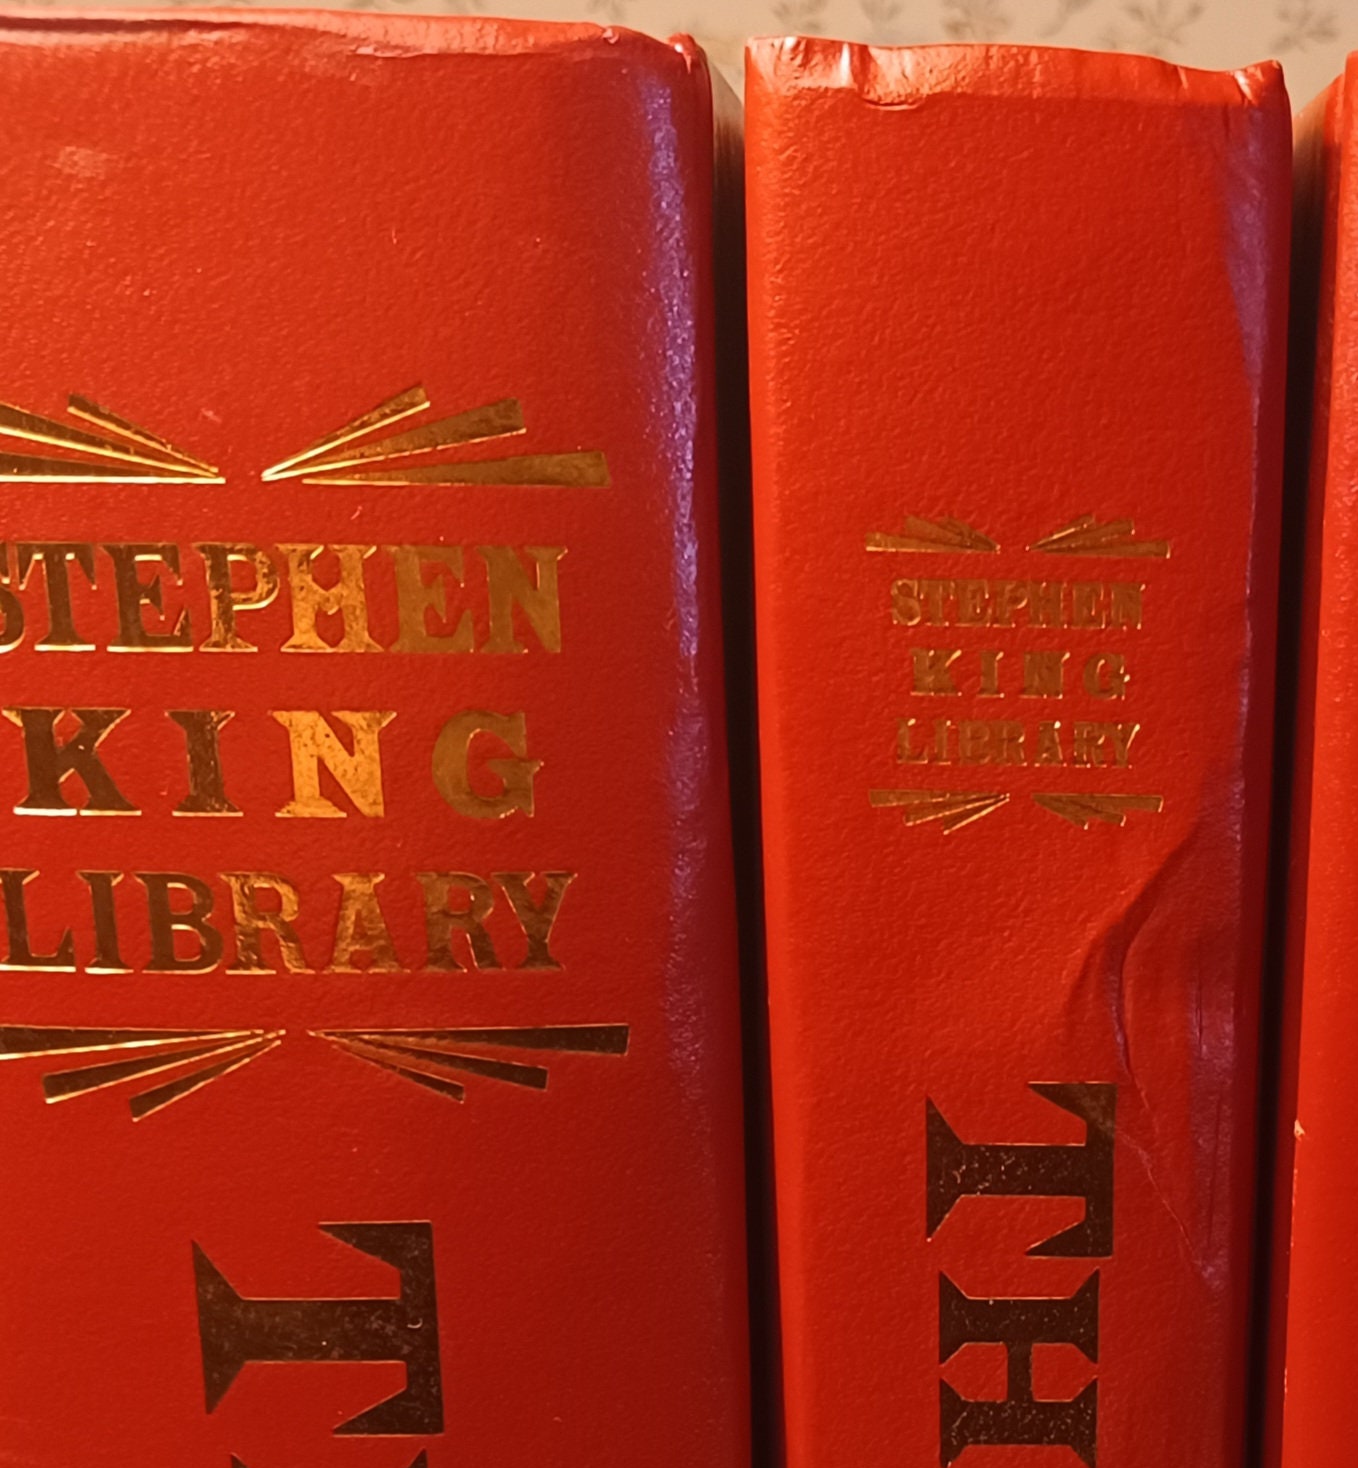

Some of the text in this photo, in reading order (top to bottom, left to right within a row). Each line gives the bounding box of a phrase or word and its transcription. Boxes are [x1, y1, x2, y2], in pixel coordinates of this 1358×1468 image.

[891, 579, 1147, 630] STEPHEN
[910, 648, 1131, 700] KING
[2, 707, 544, 819] KING
[896, 718, 1141, 769] LIBRARY
[0, 868, 579, 975] LIBRARY
